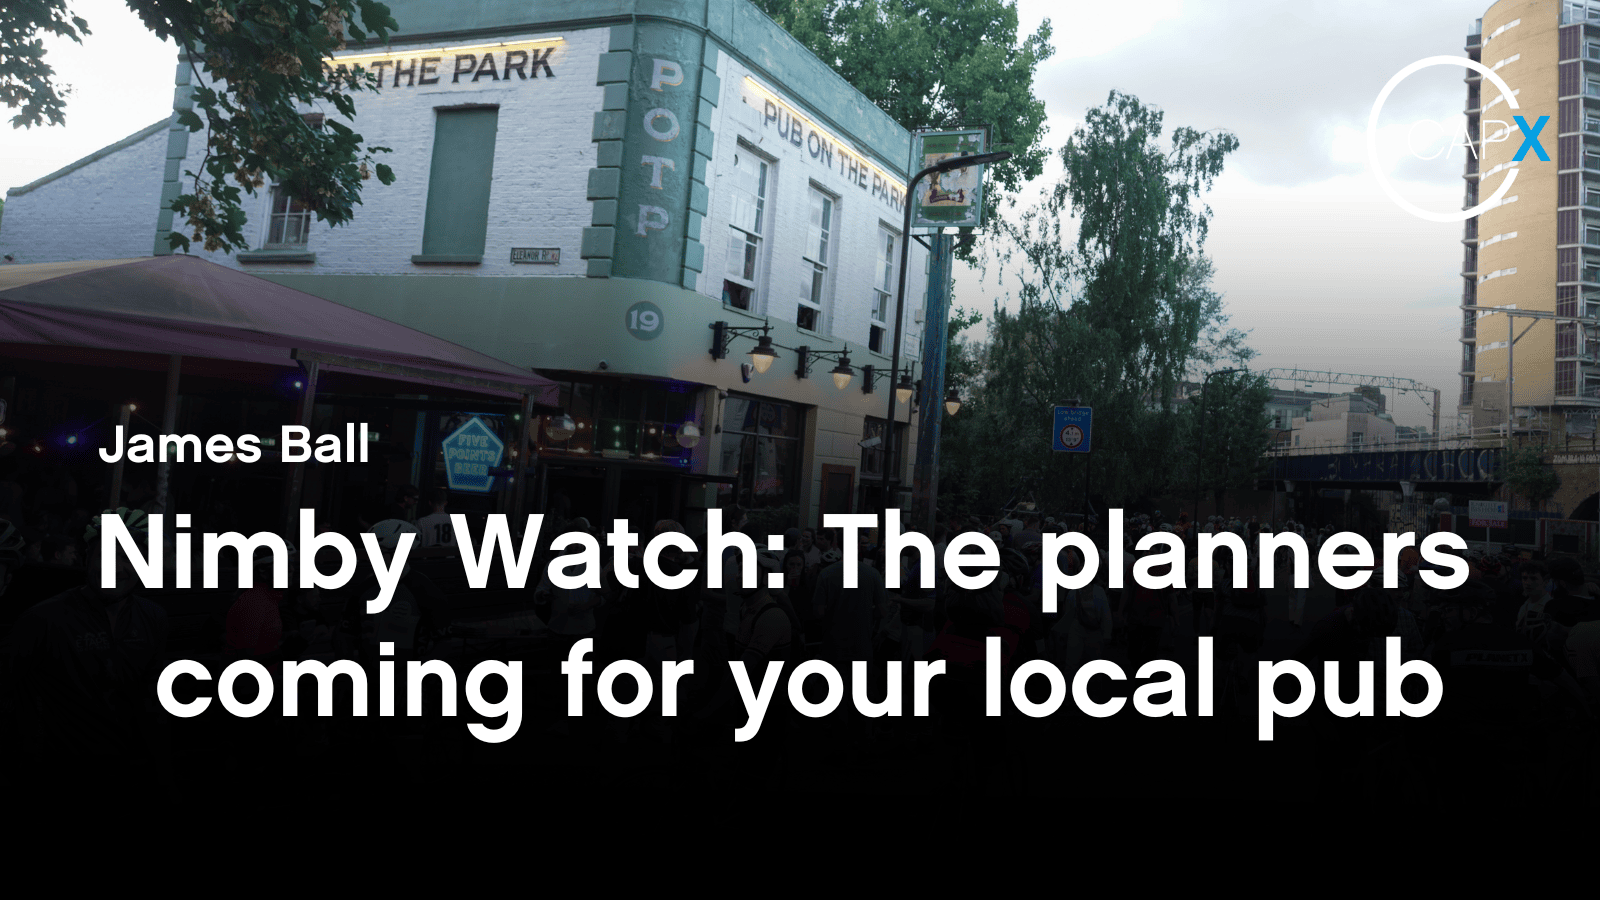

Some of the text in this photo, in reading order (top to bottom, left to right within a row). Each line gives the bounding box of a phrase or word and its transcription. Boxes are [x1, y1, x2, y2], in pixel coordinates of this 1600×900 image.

[371, 57, 441, 88] THE
[452, 47, 556, 84] PARK
[635, 58, 684, 237] POTP
[763, 98, 803, 148] PUB
[807, 130, 833, 169] ON
[838, 148, 869, 190] THE
[512, 249, 539, 260] ELEANOR
[629, 309, 660, 332] 19
[458, 433, 489, 448] FIVE
[448, 447, 496, 462] POINTS
[453, 462, 488, 476] BEER
[434, 523, 451, 544] 18
